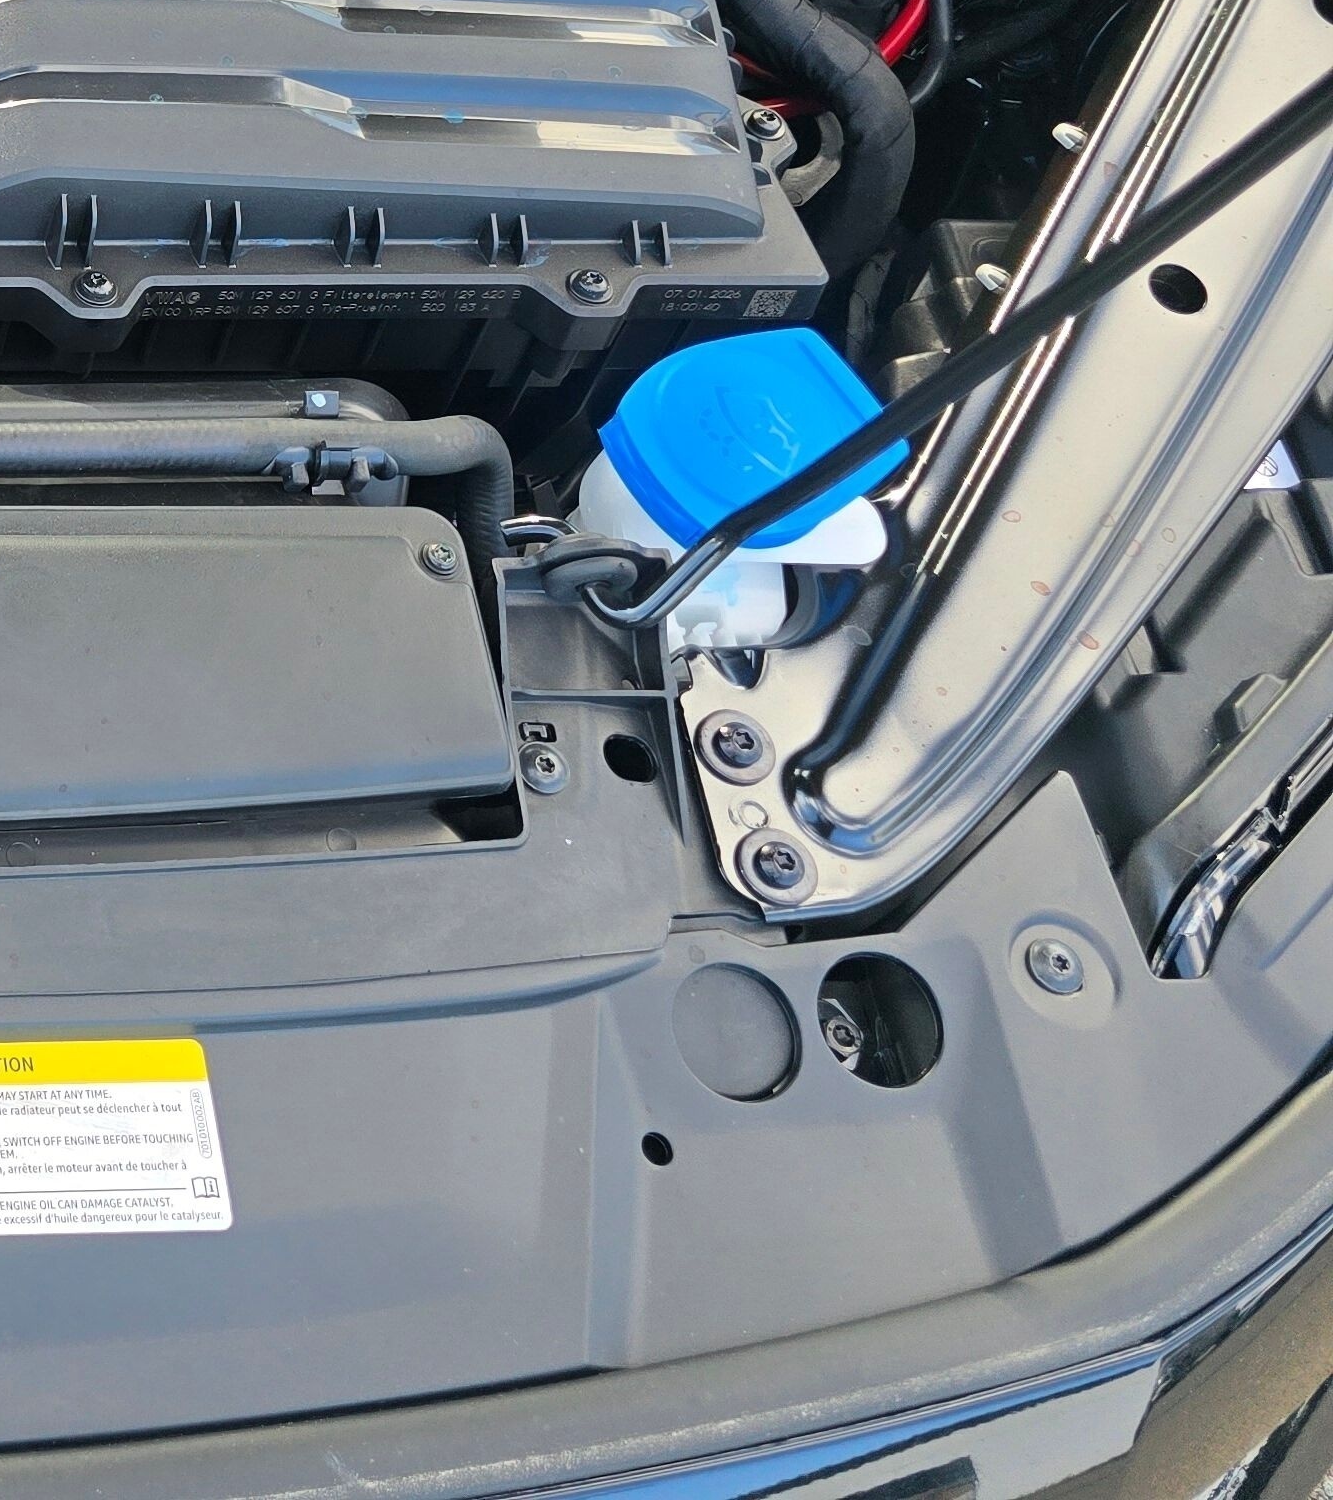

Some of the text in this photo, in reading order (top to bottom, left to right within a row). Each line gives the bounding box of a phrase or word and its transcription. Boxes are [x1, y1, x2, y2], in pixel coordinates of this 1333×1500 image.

[664, 289, 741, 299] 07.01.2026
[19, 1091, 47, 1101] START
[50, 1090, 61, 1100] AT
[64, 1090, 83, 1099] ANY
[86, 1090, 112, 1099] TIME.
[10, 1104, 55, 1115] radiateur
[58, 1105, 81, 1116] peut
[84, 1106, 94, 1114] se
[97, 1103, 150, 1114] déclencher
[152, 1104, 159, 1112] à
[161, 1103, 182, 1112] tout
[3, 1137, 40, 1147] SWITCH
[43, 1136, 61, 1146] OFF
[64, 1135, 101, 1145] ENGINE
[103, 1134, 141, 1144] BEFORE
[144, 1133, 194, 1143] TOUCHING
[8, 1163, 42, 1174] arrêter
[45, 1163, 54, 1173] le
[57, 1163, 93, 1172] moteur
[95, 1161, 124, 1172] avant
[126, 1161, 138, 1171] de
[141, 1160, 178, 1171] toucher
[181, 1160, 187, 1170] à
[0, 1200, 37, 1210] ENGINE
[39, 1200, 56, 1209] OIL
[58, 1200, 78, 1209] CAN
[81, 1199, 123, 1208] DAMAGE
[125, 1197, 173, 1207] CATALYST.
[4, 1213, 42, 1224] excessif
[45, 1212, 78, 1223] d'huile
[81, 1212, 133, 1224] dangereux
[135, 1213, 157, 1223] pour
[159, 1211, 169, 1220] le
[172, 1210, 223, 1222] catalyseur.
